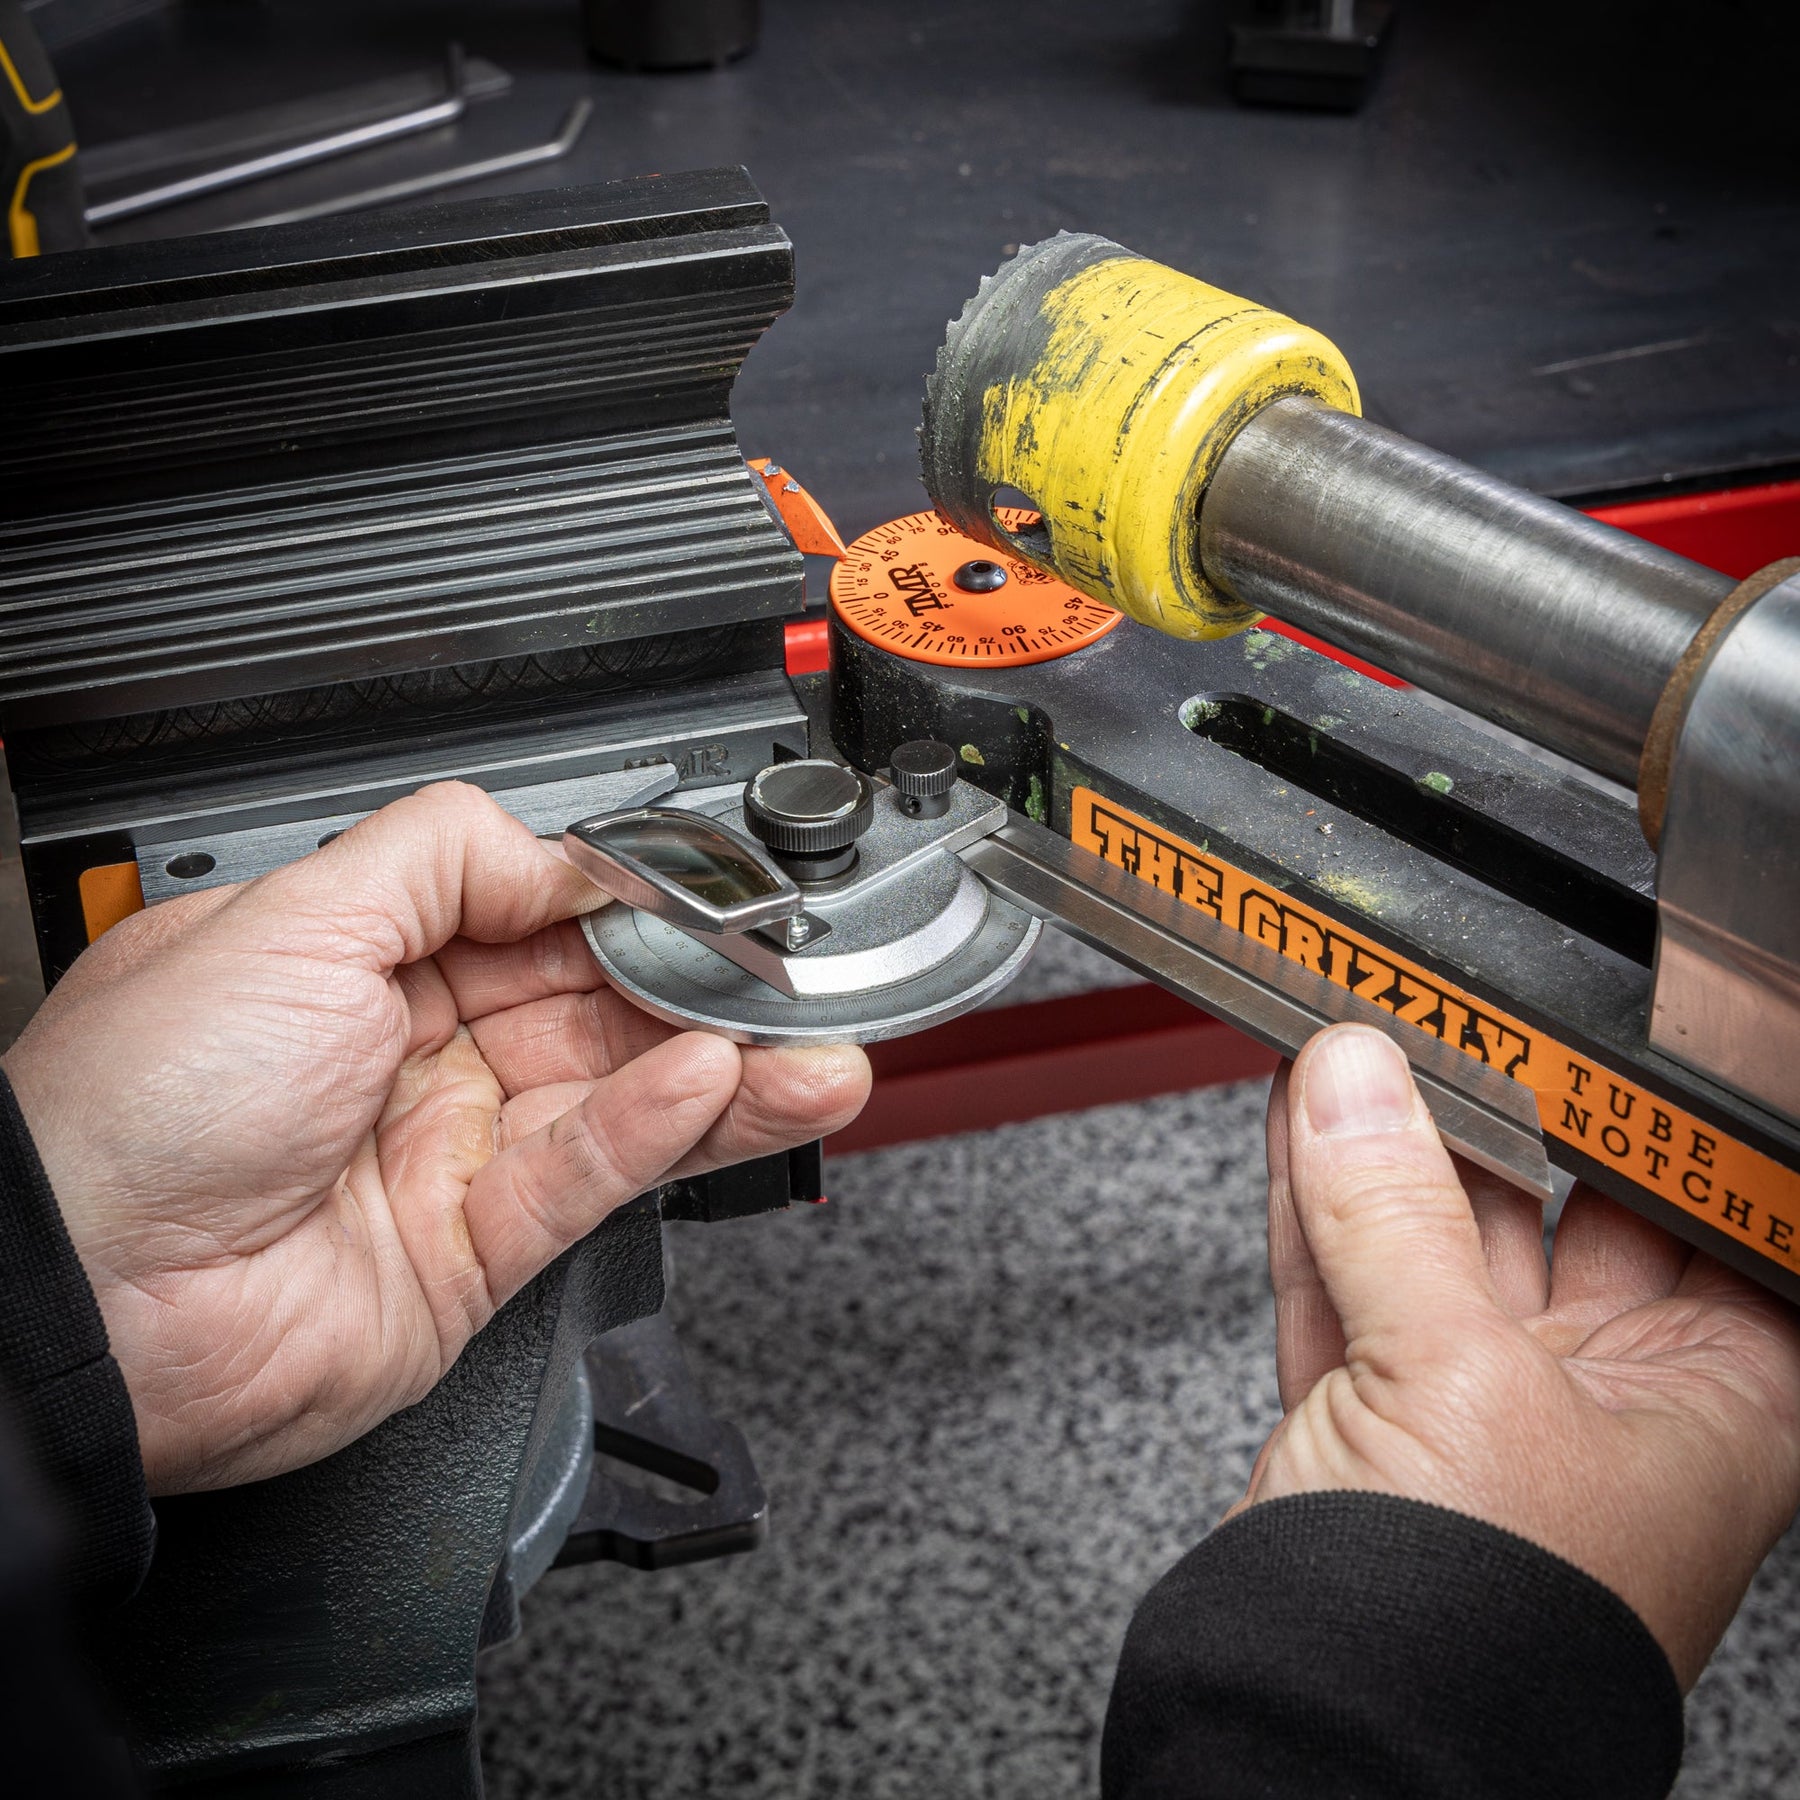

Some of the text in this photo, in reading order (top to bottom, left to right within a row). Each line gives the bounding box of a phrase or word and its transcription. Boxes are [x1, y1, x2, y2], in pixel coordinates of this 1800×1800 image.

[908, 526, 926, 535] 75
[886, 535, 902, 545] 60
[880, 549, 900, 563] 45
[859, 562, 873, 573] 30
[856, 577, 869, 587] 15
[873, 592, 889, 600] 0
[1063, 596, 1084, 611] 45
[872, 607, 887, 617] 15
[891, 619, 909, 630] 30
[1062, 615, 1079, 625] 60
[920, 621, 945, 633] 45
[1001, 624, 1027, 636] 90
[1037, 626, 1057, 636] 75
[946, 635, 965, 643] 60
[978, 636, 996, 645] 75
[1091, 803, 1531, 1079] THE GRIZZLY
[1567, 1061, 1717, 1169] TUBE
